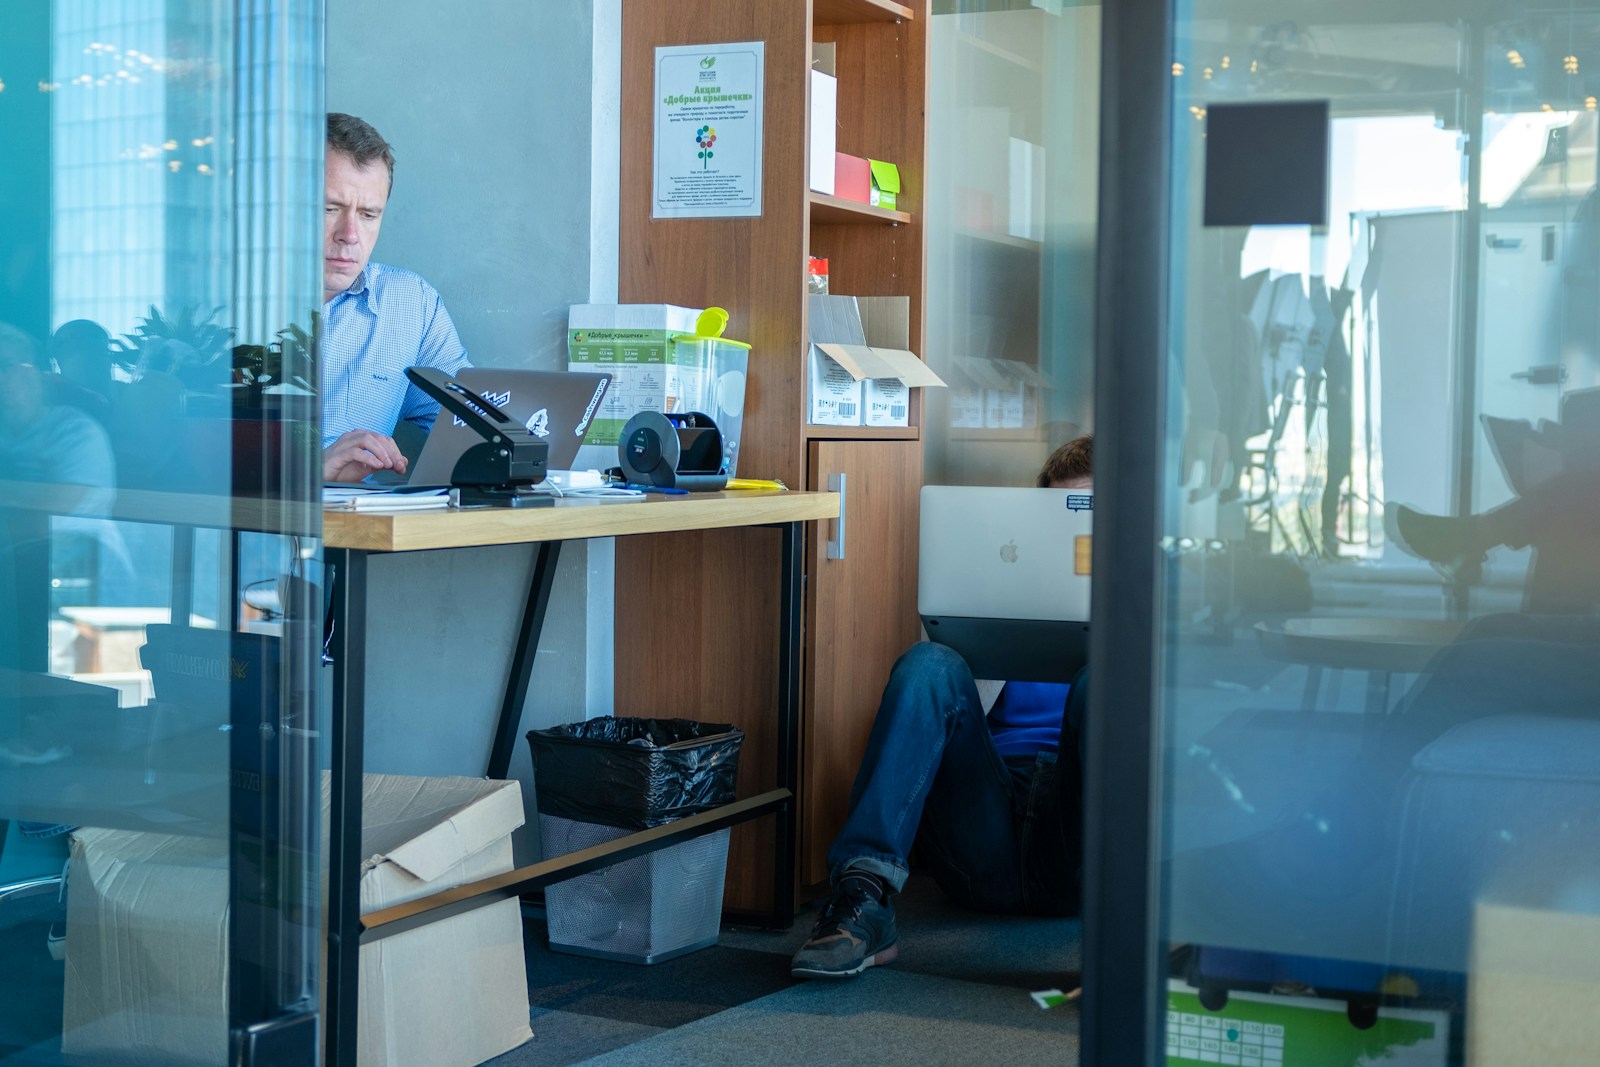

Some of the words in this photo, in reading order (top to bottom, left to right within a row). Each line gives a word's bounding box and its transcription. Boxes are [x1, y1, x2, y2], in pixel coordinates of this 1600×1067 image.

[694, 86, 721, 95] Акция
[664, 95, 701, 105] «Добрые
[703, 94, 752, 104] крышечки»
[583, 380, 606, 422] cashwagon
[1224, 1021, 1239, 1029] 100
